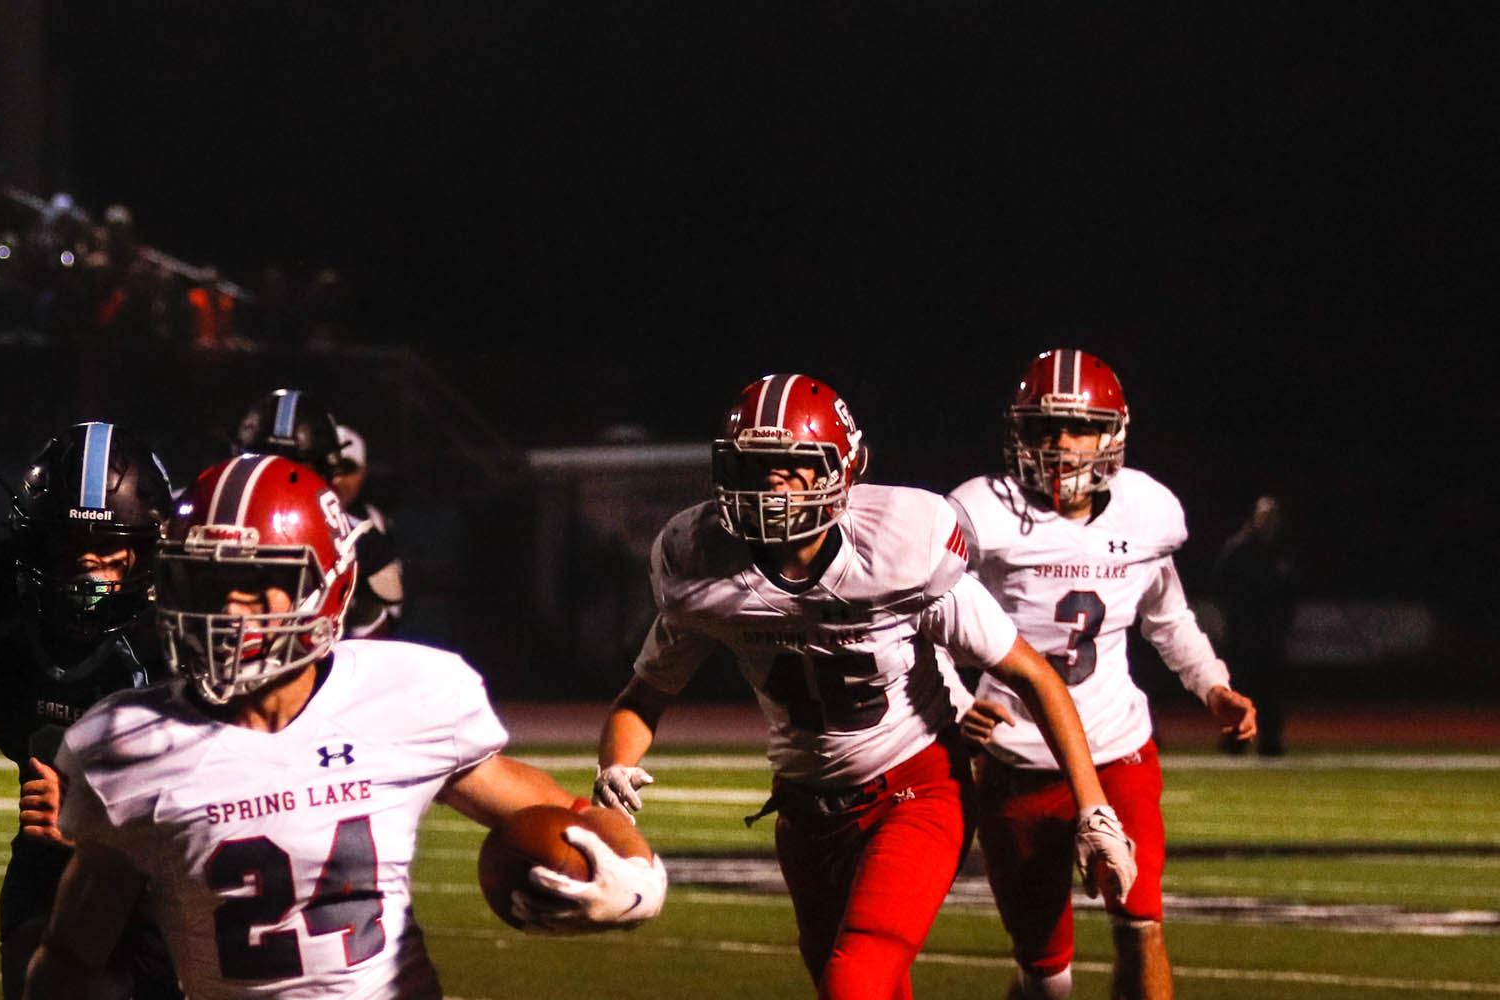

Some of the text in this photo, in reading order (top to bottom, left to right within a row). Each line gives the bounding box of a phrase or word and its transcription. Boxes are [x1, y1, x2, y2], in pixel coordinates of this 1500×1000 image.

[68, 507, 114, 521] Riddell
[1034, 564, 1128, 579] SPRING LAKE
[1044, 590, 1106, 686] 3
[35, 698, 84, 719] EAGLE
[206, 779, 372, 825] SPRING LAKE
[204, 814, 387, 980] 24
